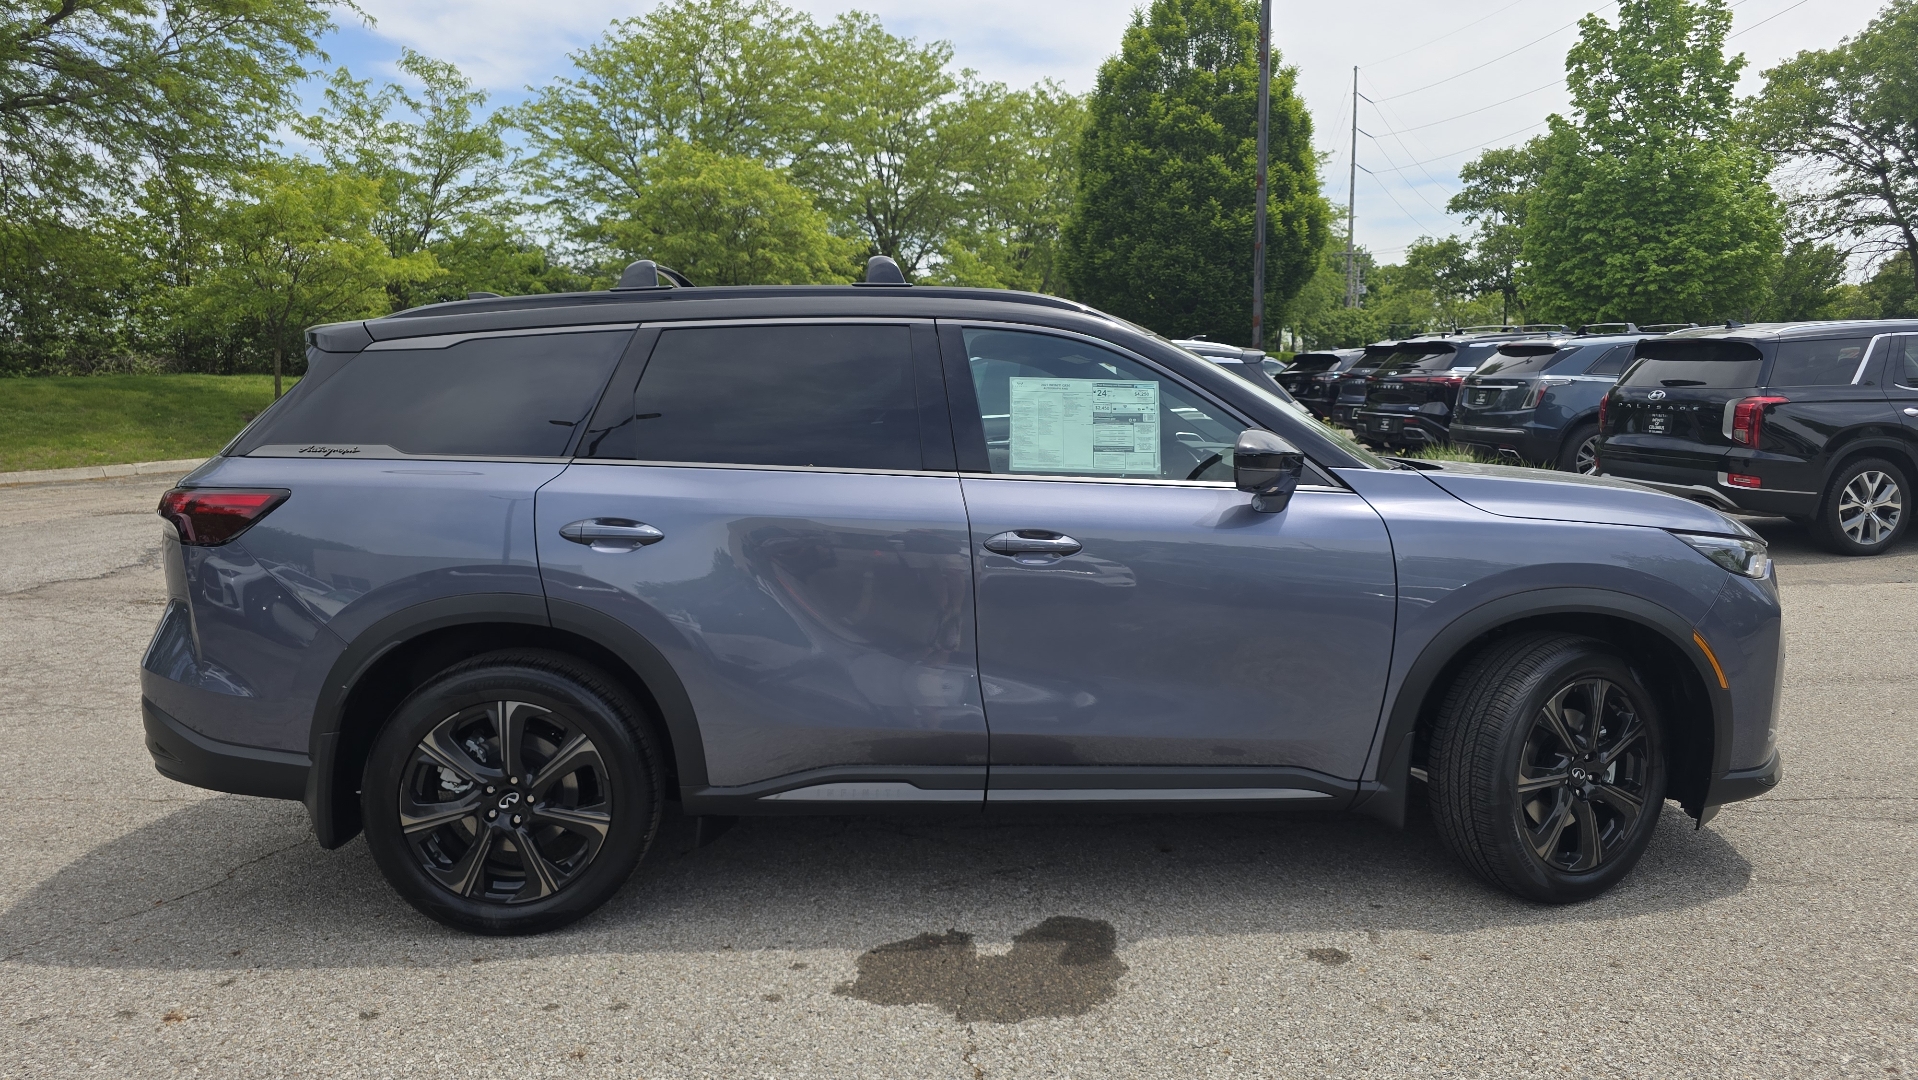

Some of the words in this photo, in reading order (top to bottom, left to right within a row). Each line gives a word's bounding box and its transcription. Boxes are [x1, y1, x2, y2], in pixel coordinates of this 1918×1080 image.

[1096, 389, 1107, 397] 24
[1618, 402, 1700, 411] PALISADE
[298, 445, 361, 457] Autograph
[816, 788, 901, 798] INFINITI
